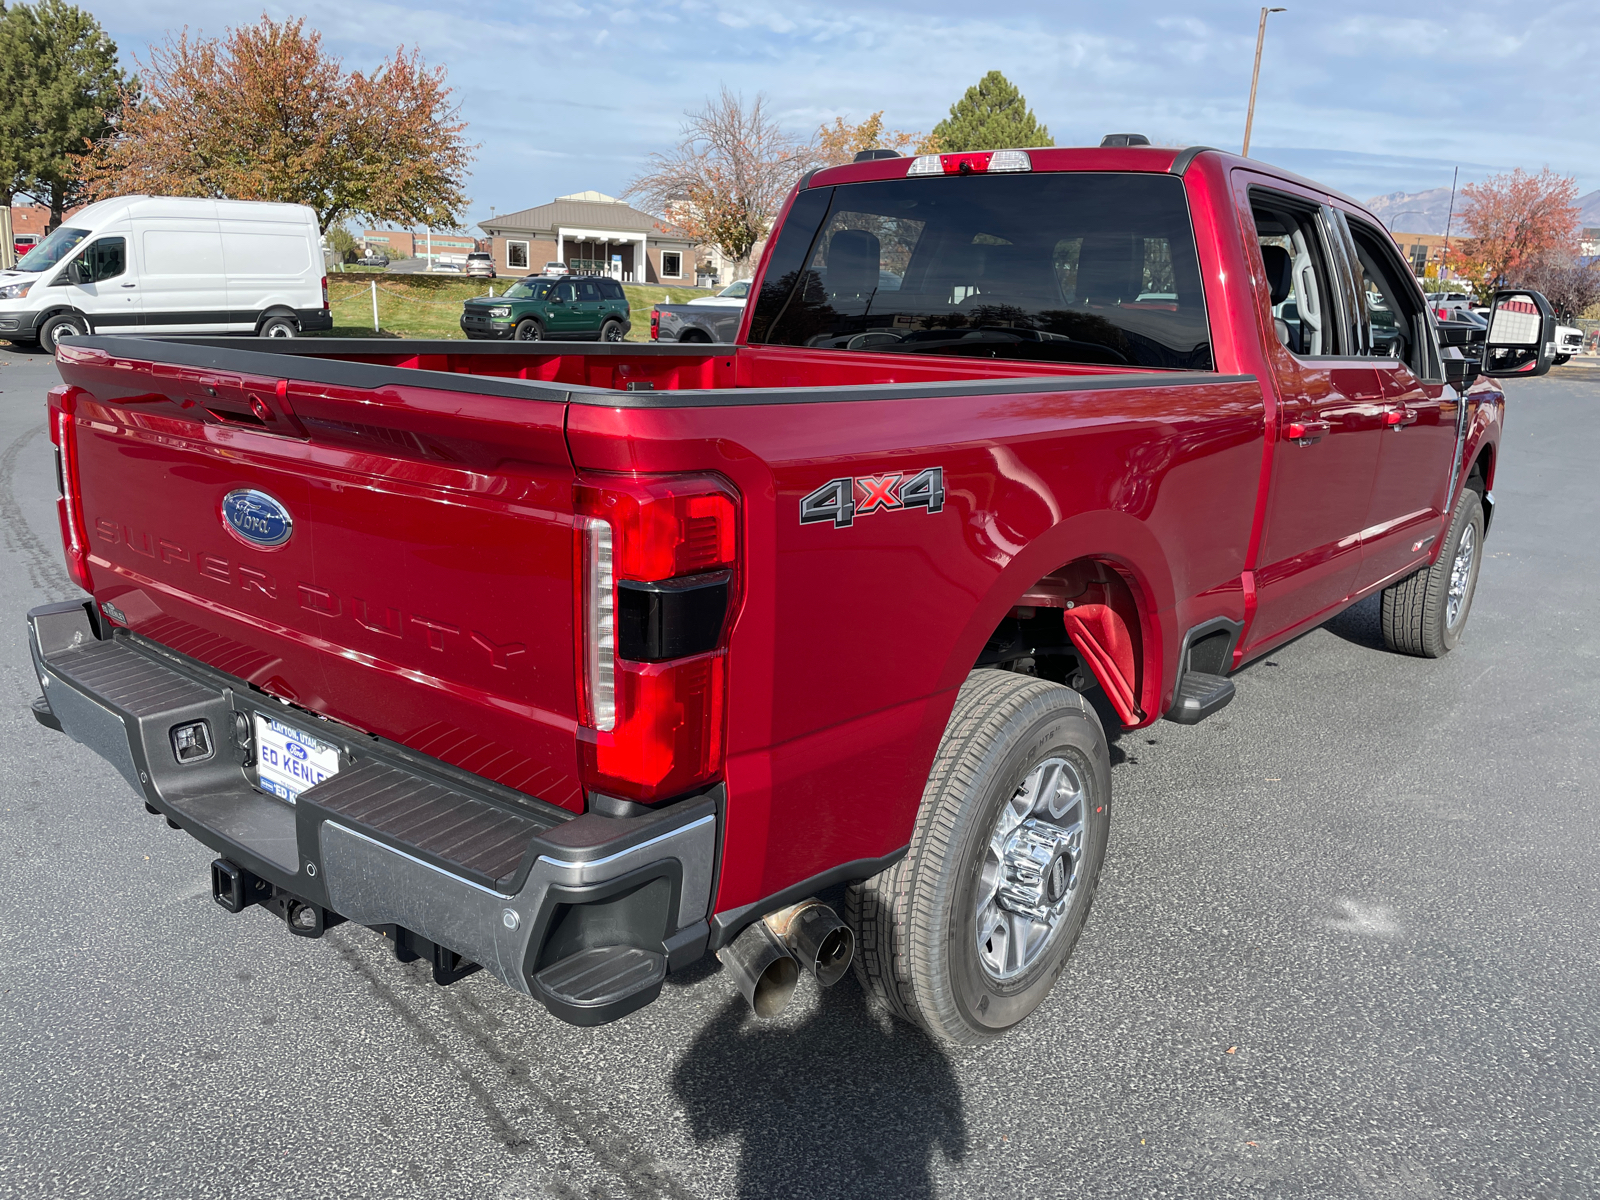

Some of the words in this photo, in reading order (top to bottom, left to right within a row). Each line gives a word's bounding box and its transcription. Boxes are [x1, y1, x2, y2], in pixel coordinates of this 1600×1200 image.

[233, 500, 271, 534] Ford
[95, 516, 278, 600] SUPER
[296, 580, 527, 671] DUTY
[271, 720, 299, 741] LAYTON,
[299, 731, 317, 750] UTAH
[288, 743, 305, 759] Ford
[261, 745, 279, 767] ED
[283, 754, 328, 786] KENLE
